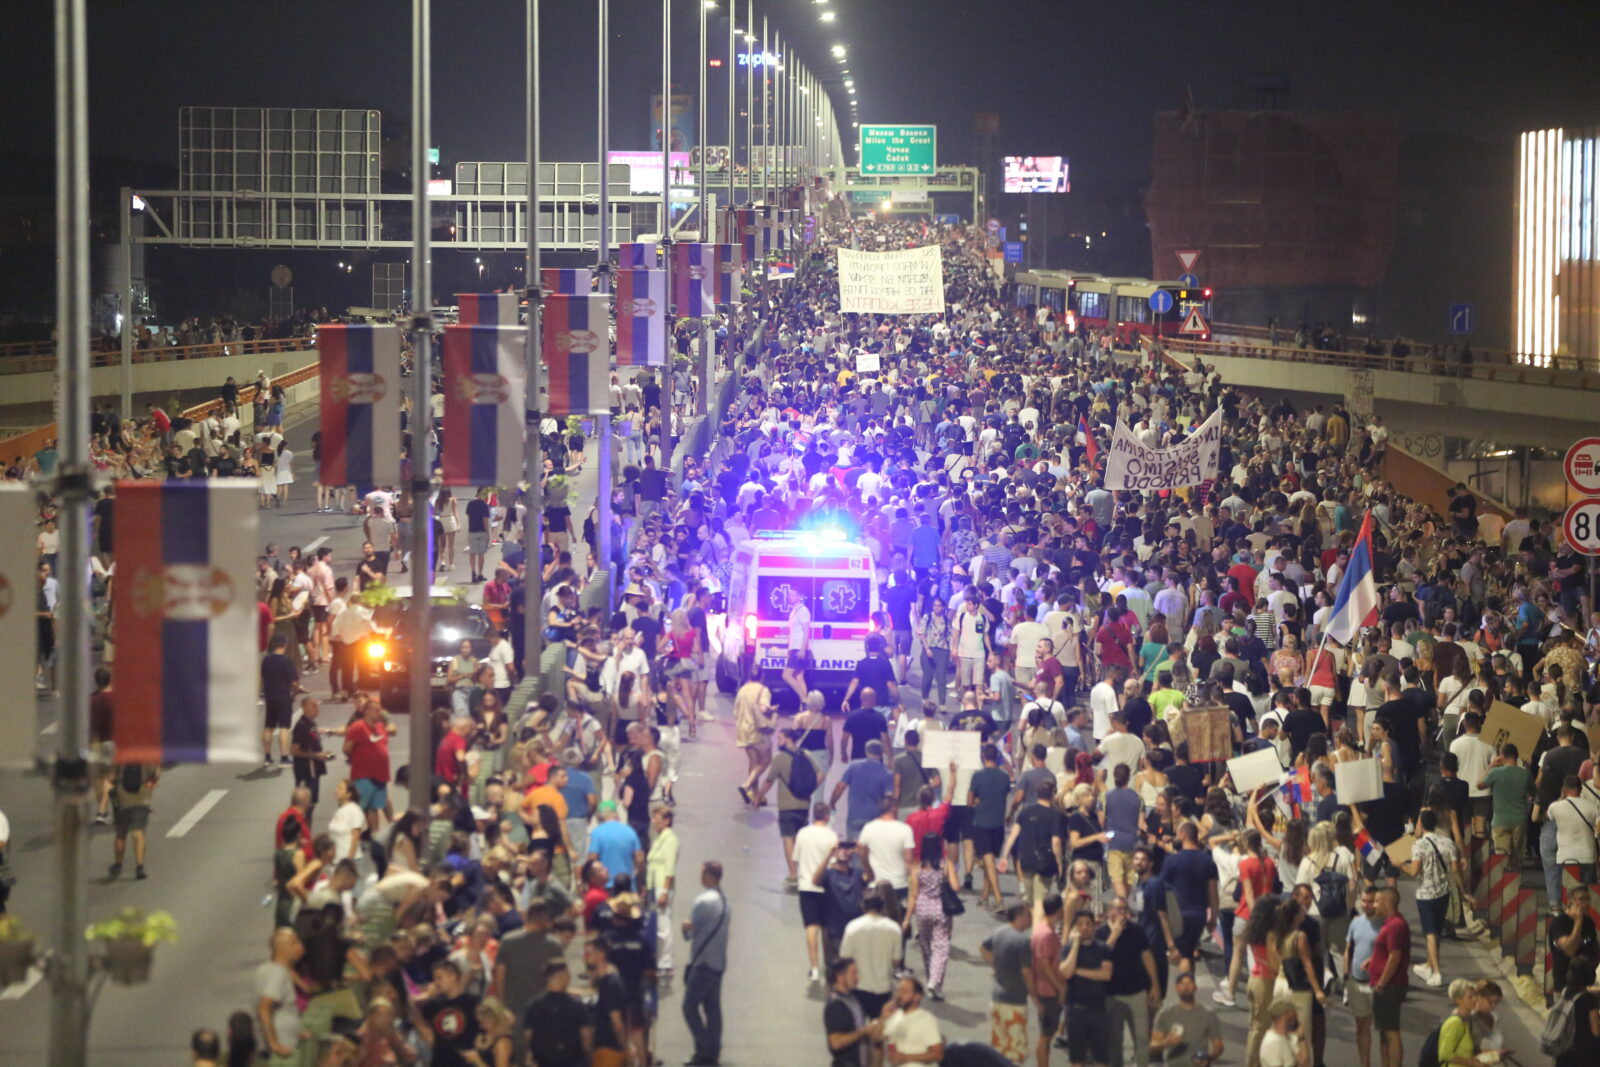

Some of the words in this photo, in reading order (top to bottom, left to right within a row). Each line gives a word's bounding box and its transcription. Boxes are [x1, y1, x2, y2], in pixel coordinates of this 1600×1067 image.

[737, 51, 781, 68] zept
[1575, 512, 1600, 541] 8
[851, 559, 861, 568] 62
[760, 658, 857, 669] AMLANC
